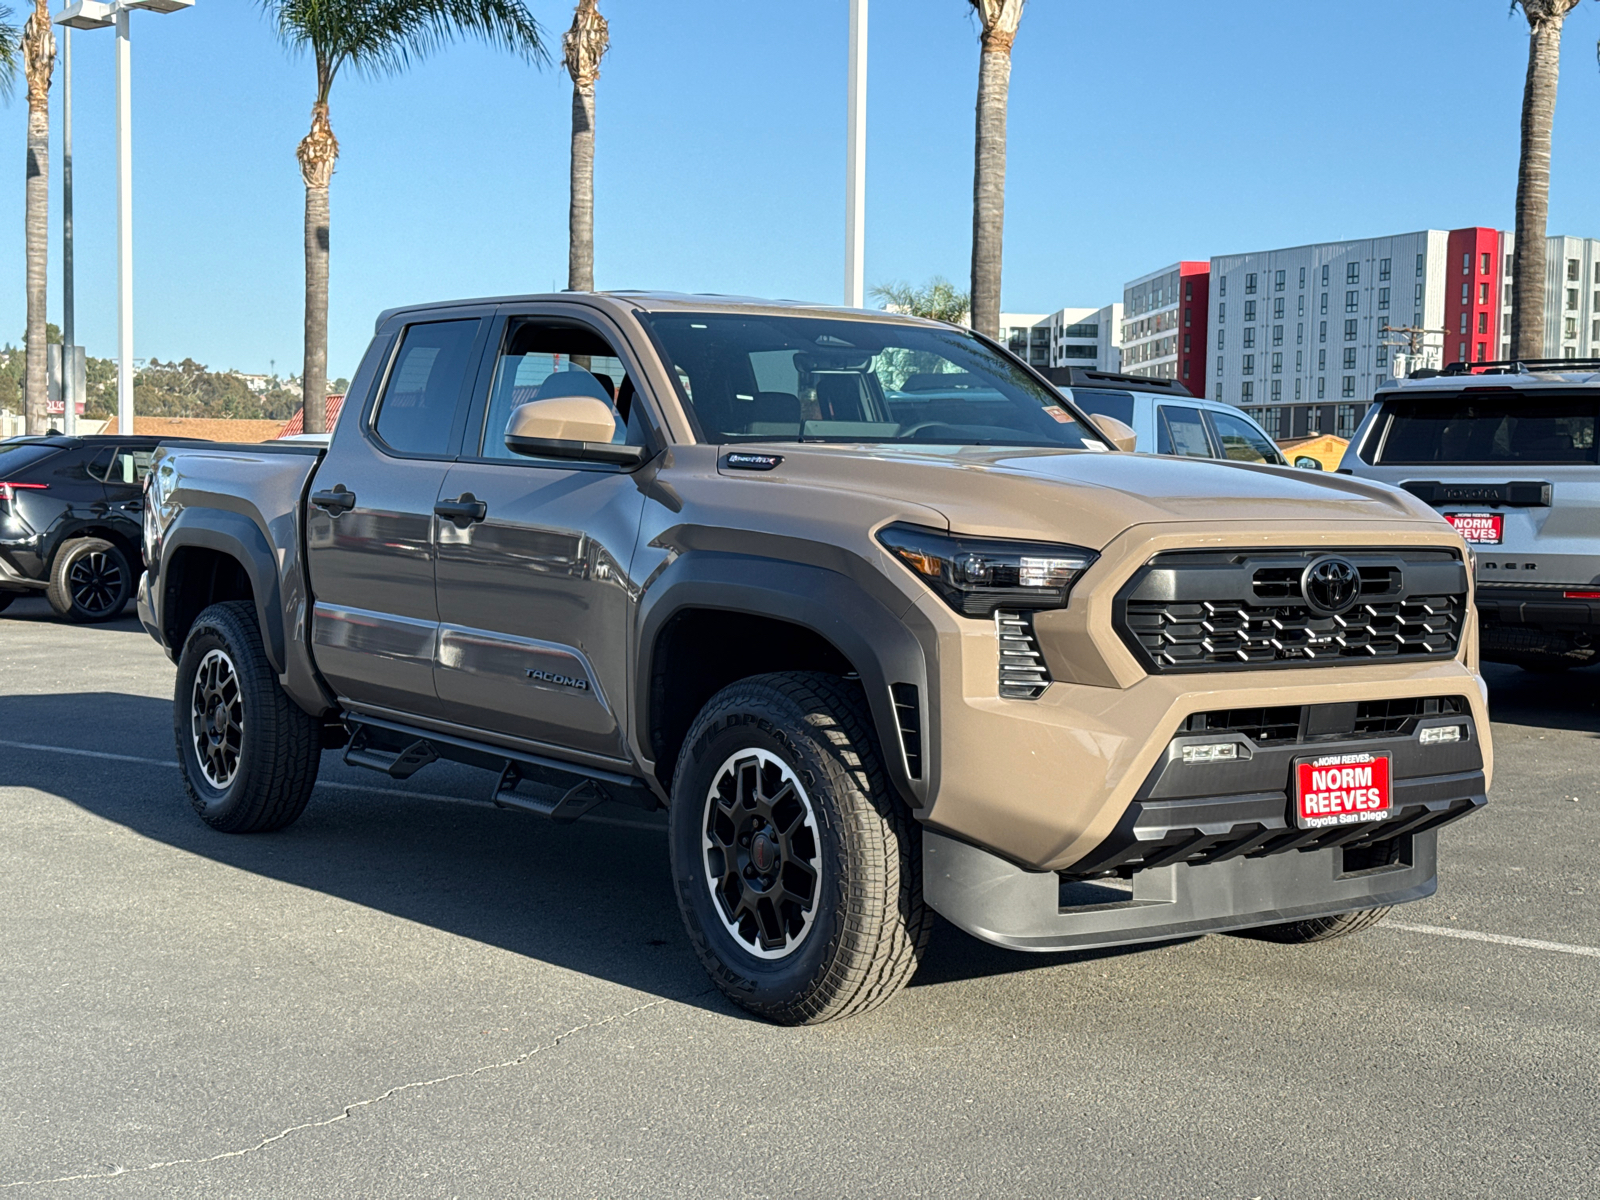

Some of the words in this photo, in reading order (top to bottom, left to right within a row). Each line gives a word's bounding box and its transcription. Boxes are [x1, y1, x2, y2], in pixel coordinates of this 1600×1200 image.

[1443, 488, 1499, 499] TOYOTA
[1454, 518, 1493, 529] NORM
[1456, 528, 1497, 539] EEVES
[524, 668, 588, 690] TACOMA
[1318, 755, 1341, 766] NORM
[1341, 753, 1370, 764] REEVES
[1312, 766, 1373, 791] NORM
[1305, 788, 1381, 814] REEVES
[1305, 816, 1338, 828] Toyota
[1339, 814, 1359, 824] San
[1360, 811, 1388, 821] Diego
